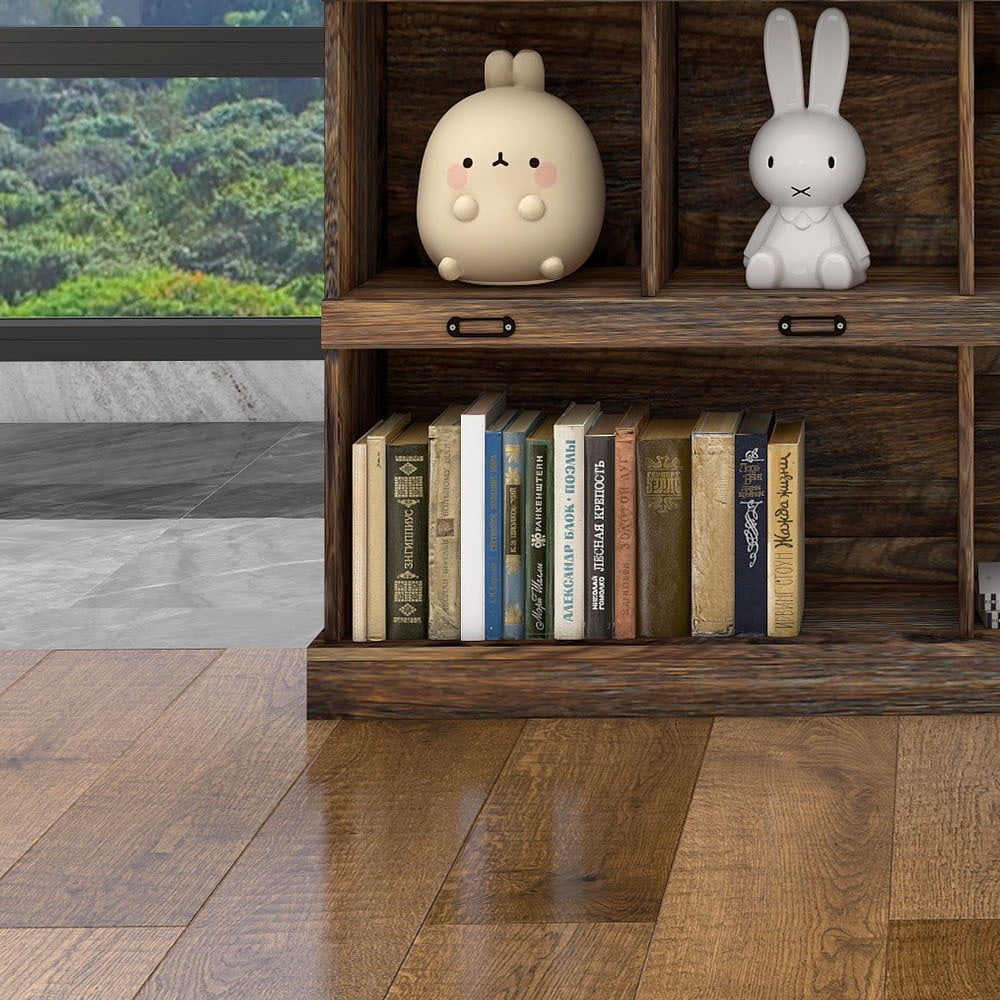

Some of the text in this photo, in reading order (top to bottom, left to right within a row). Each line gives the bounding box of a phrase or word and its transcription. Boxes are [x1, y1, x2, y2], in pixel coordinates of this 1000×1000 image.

[562, 439, 576, 623] АЛЕКСАНДР БЛОК ПОЭМЫ
[593, 460, 605, 572] ЛЕСНАЯ КРЕПОСТЬ
[774, 452, 794, 631] ИРВИНГ СТОУН Жажда жизни
